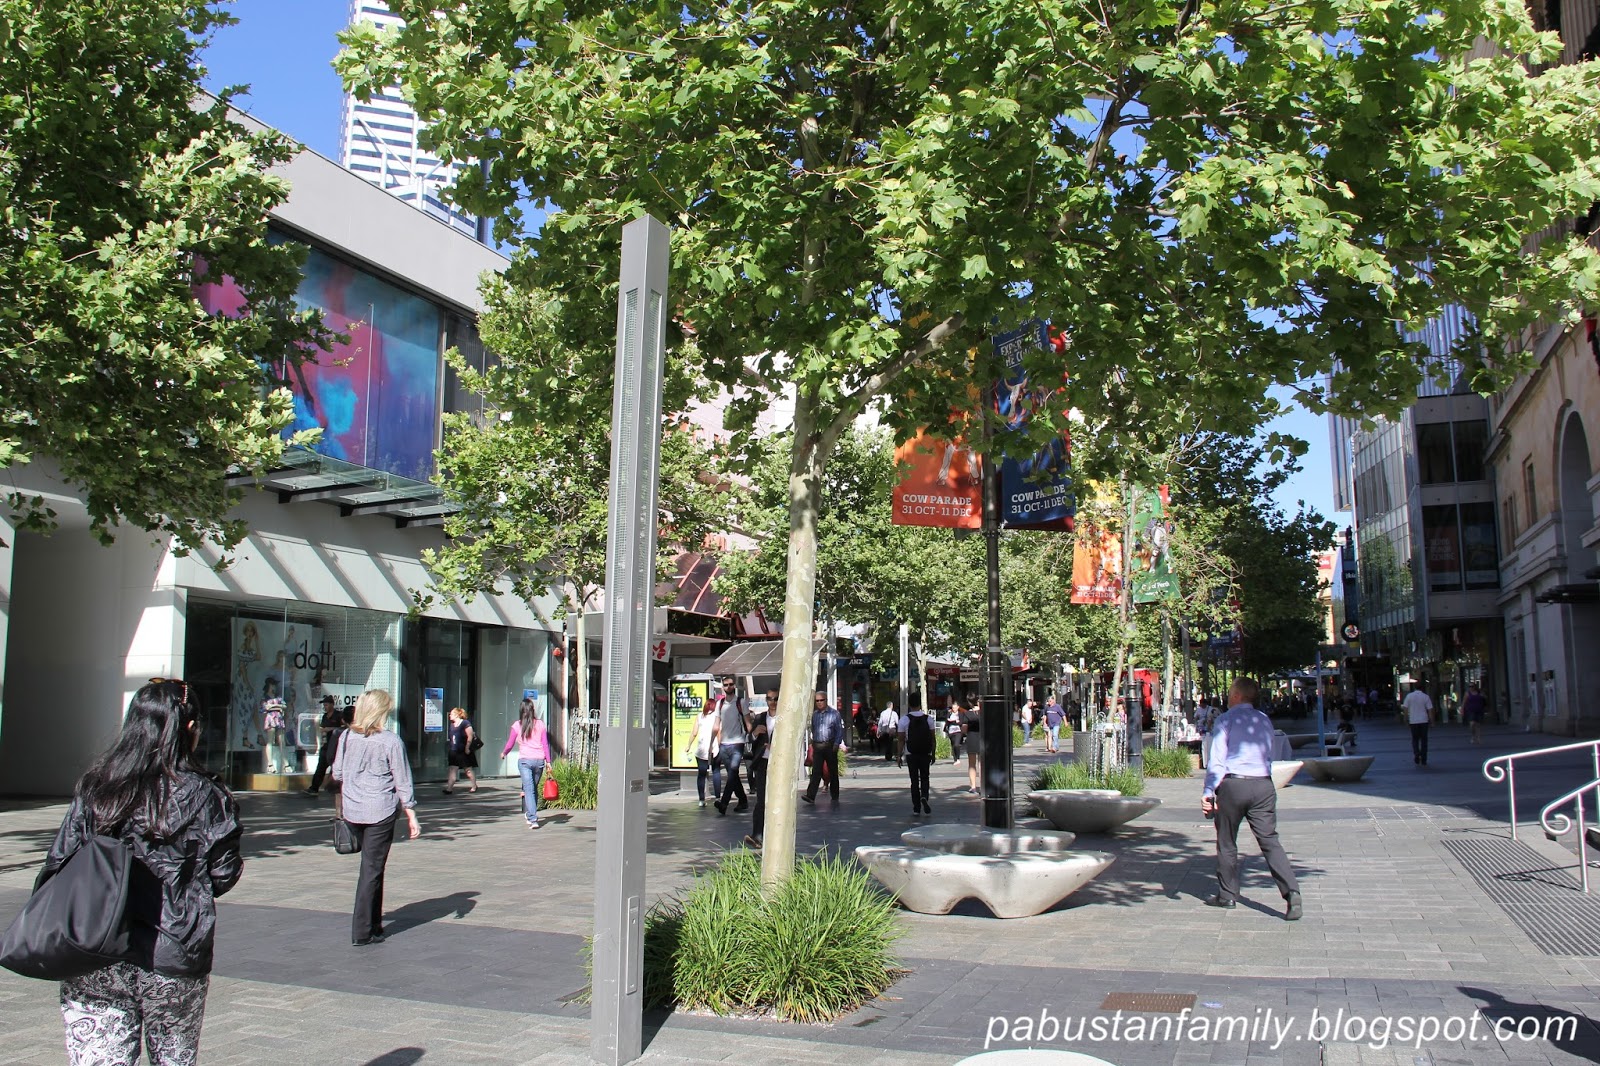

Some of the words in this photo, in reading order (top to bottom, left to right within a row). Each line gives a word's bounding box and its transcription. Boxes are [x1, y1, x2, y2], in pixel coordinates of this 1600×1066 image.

[1011, 491, 1034, 503] COW
[1035, 484, 1066, 500] PADE
[902, 494, 928, 504] COW
[929, 495, 972, 506] PARADE
[902, 505, 913, 514] 31
[952, 507, 972, 517] DEC
[1011, 505, 1022, 514] 31
[294, 639, 336, 671] dotti
[676, 697, 702, 708] WHO?
